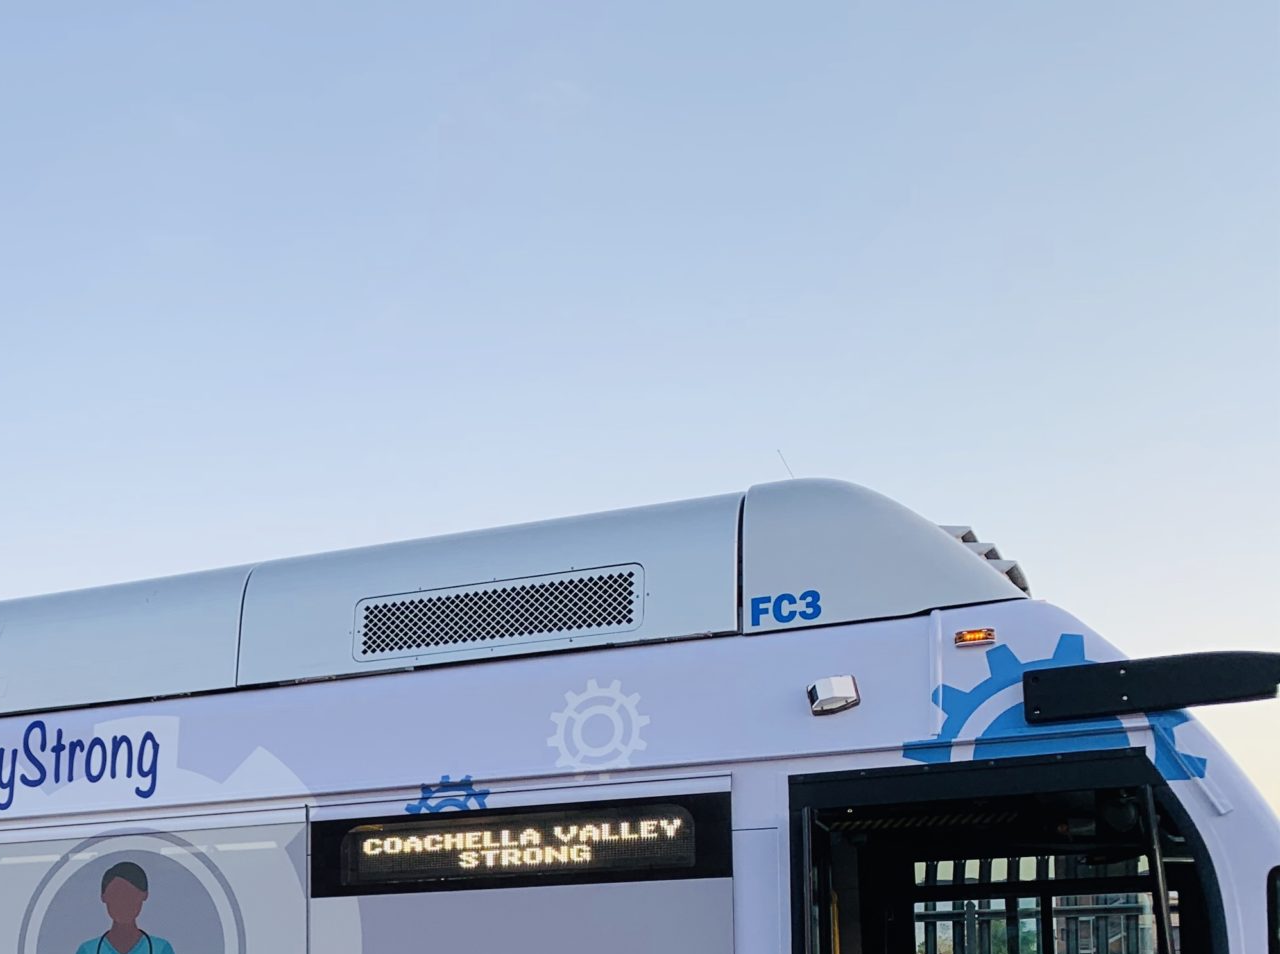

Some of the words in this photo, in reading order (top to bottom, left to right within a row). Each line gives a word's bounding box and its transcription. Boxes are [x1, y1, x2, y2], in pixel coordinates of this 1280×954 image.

[750, 589, 822, 627] FC3
[362, 827, 541, 857] COACHELLA
[553, 817, 682, 844] VALLEY
[458, 845, 593, 869] STRONG
